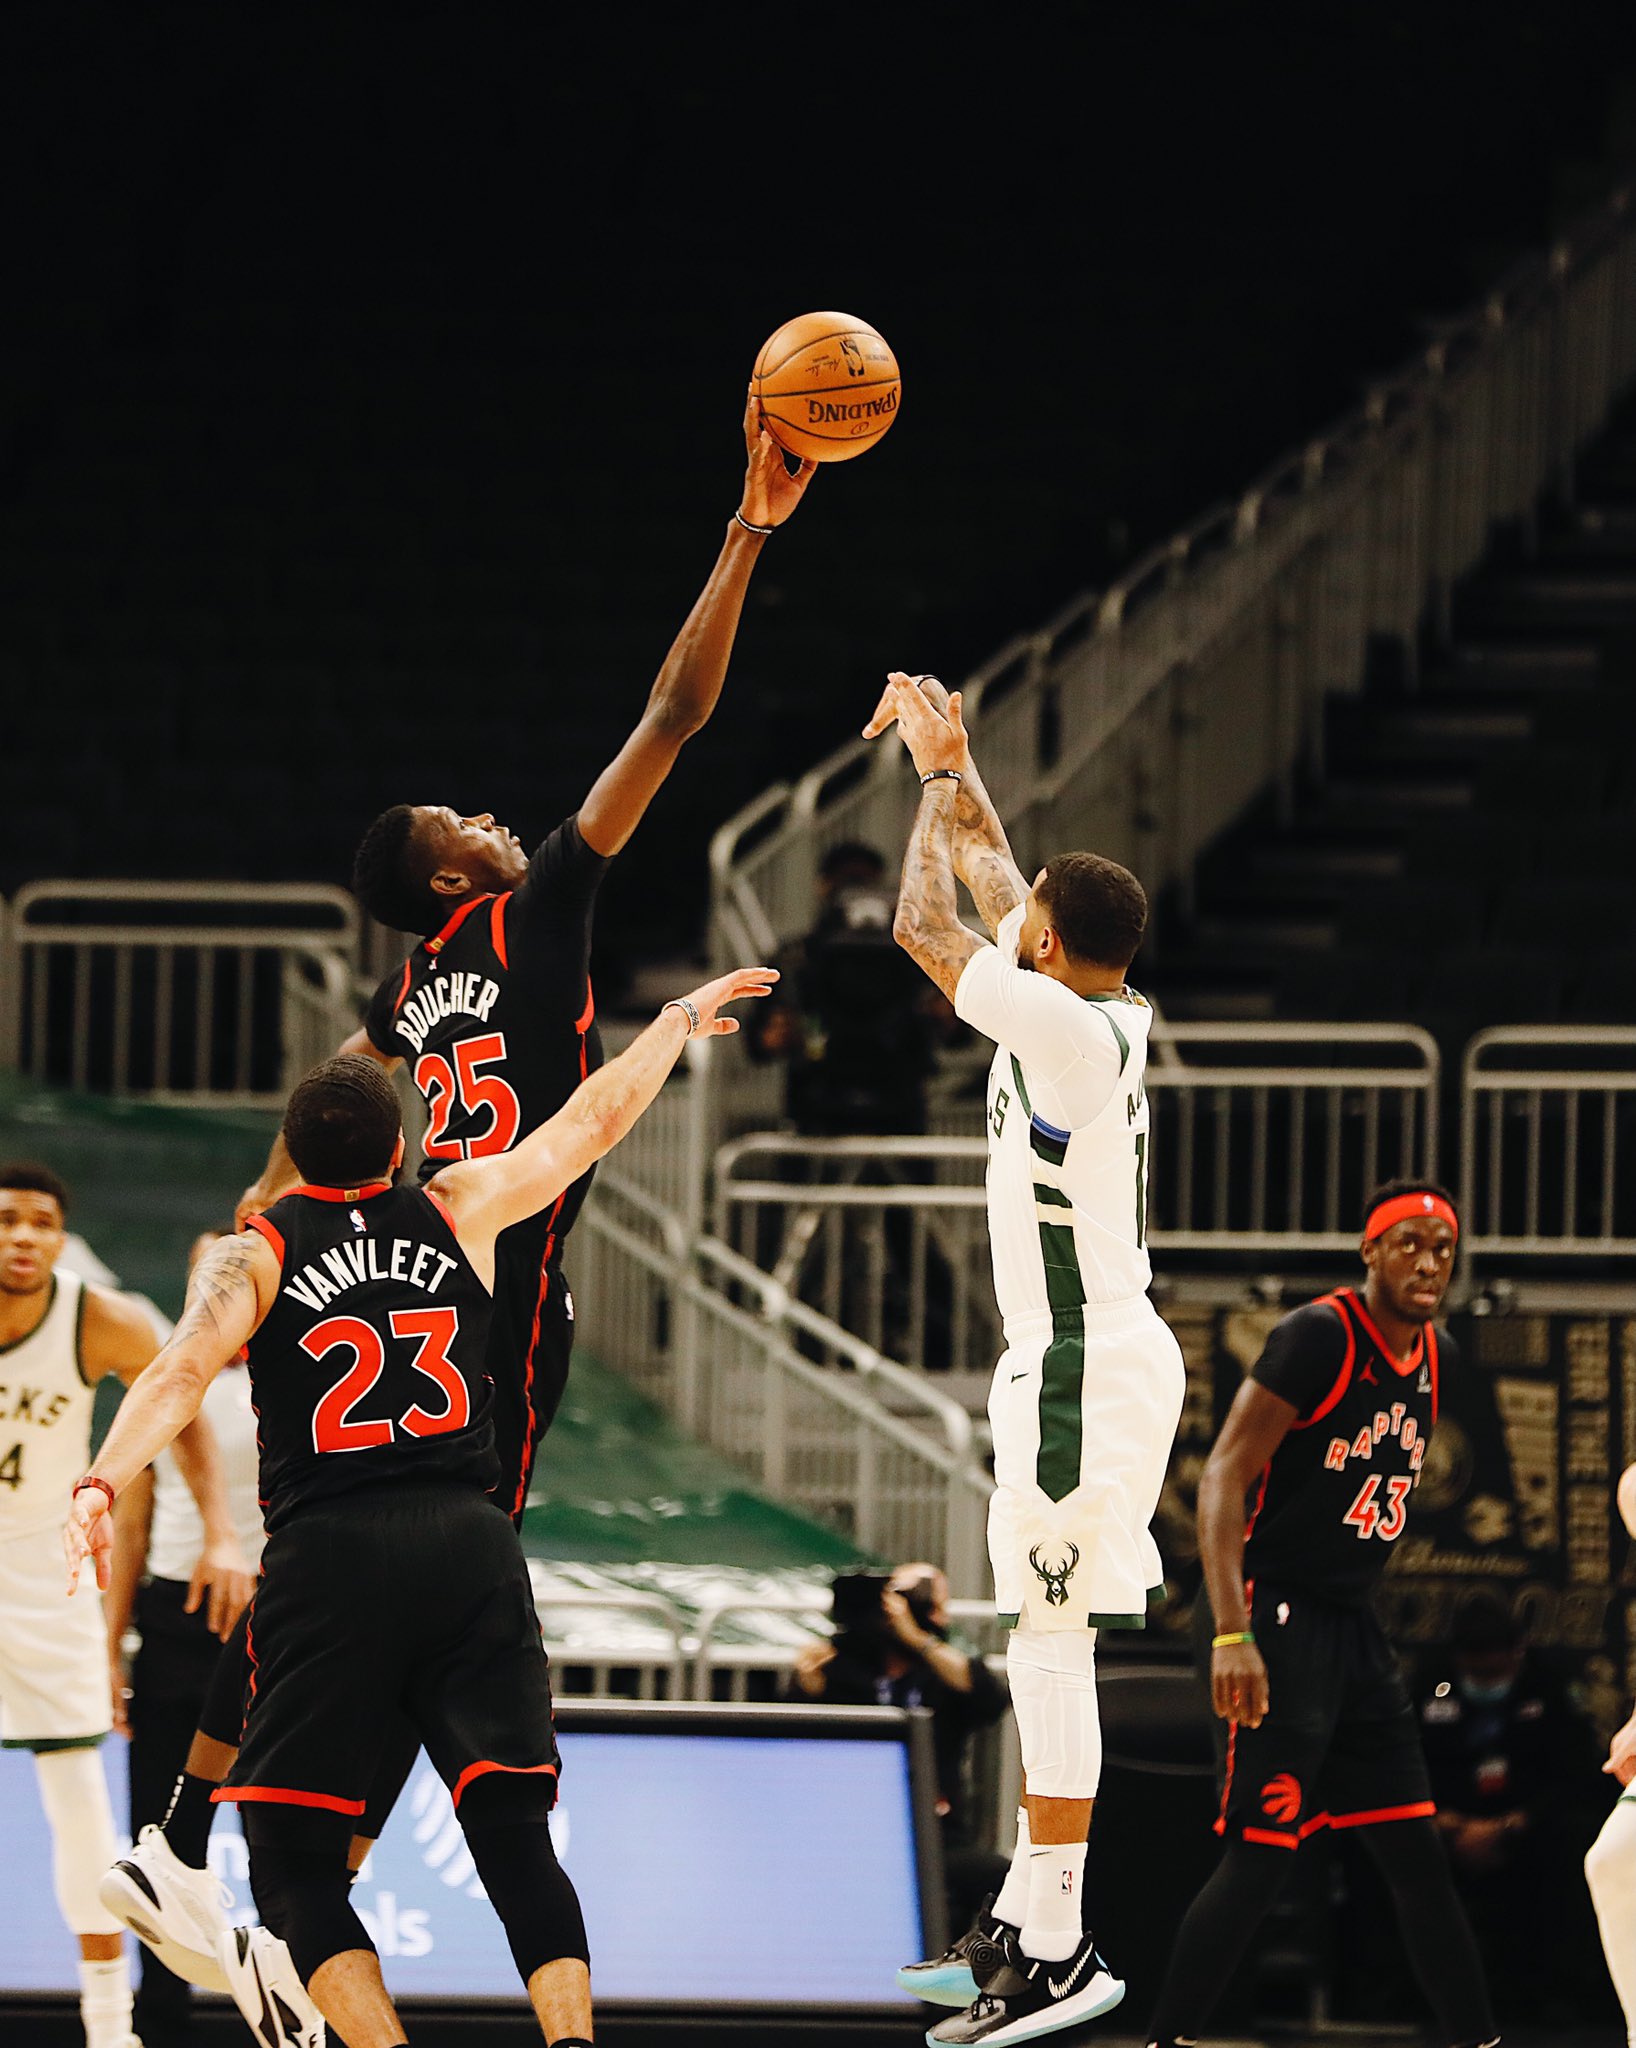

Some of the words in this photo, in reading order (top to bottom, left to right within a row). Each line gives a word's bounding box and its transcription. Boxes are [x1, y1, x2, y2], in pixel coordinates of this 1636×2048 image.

[808, 387, 898, 424] SPALDING
[396, 971, 500, 1054] BOUCHER
[414, 1031, 521, 1160] 25
[283, 1238, 459, 1312] VANVLEET
[298, 1306, 470, 1454] 23
[1323, 1402, 1426, 1489] RAPTOR
[1342, 1474, 1413, 1541] 43
